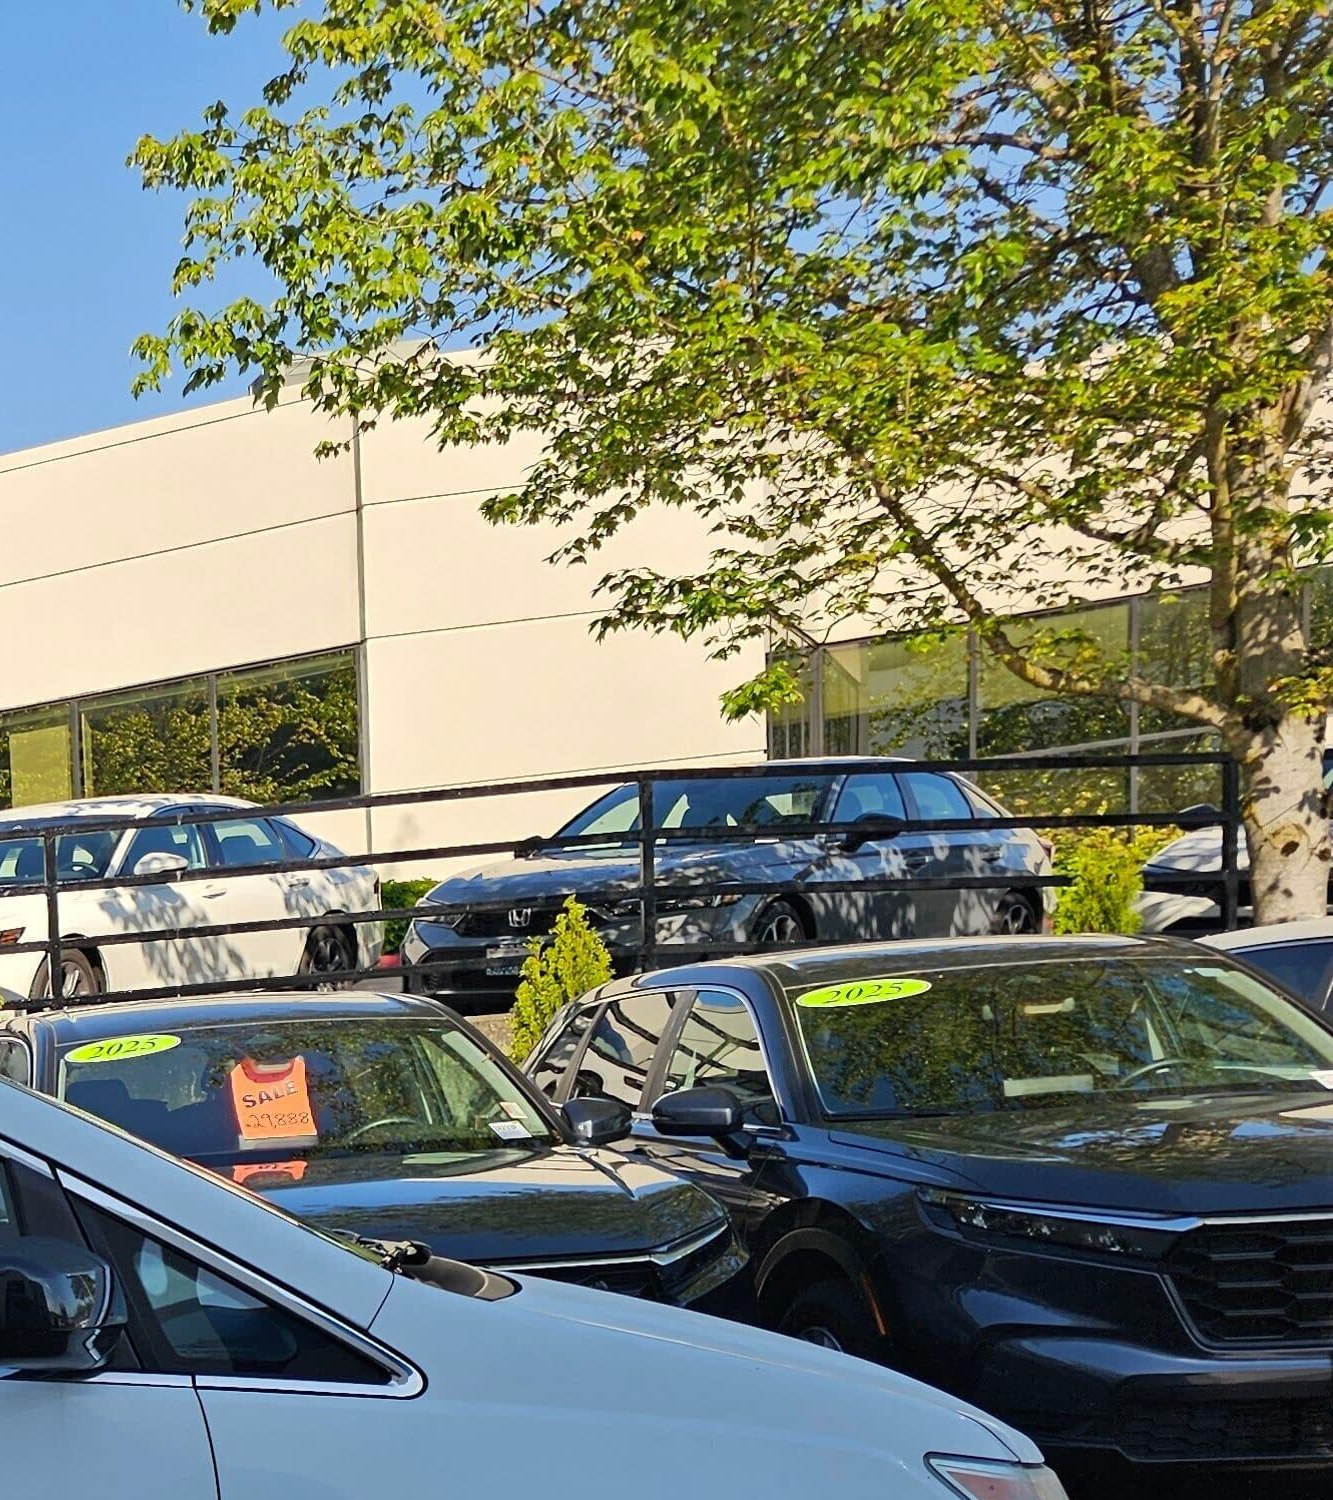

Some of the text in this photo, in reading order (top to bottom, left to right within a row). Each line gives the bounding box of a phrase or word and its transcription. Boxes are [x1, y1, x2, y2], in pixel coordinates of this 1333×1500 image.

[822, 982, 904, 1004] 2025
[87, 1037, 158, 1060] 2025
[242, 1080, 299, 1108] SALE
